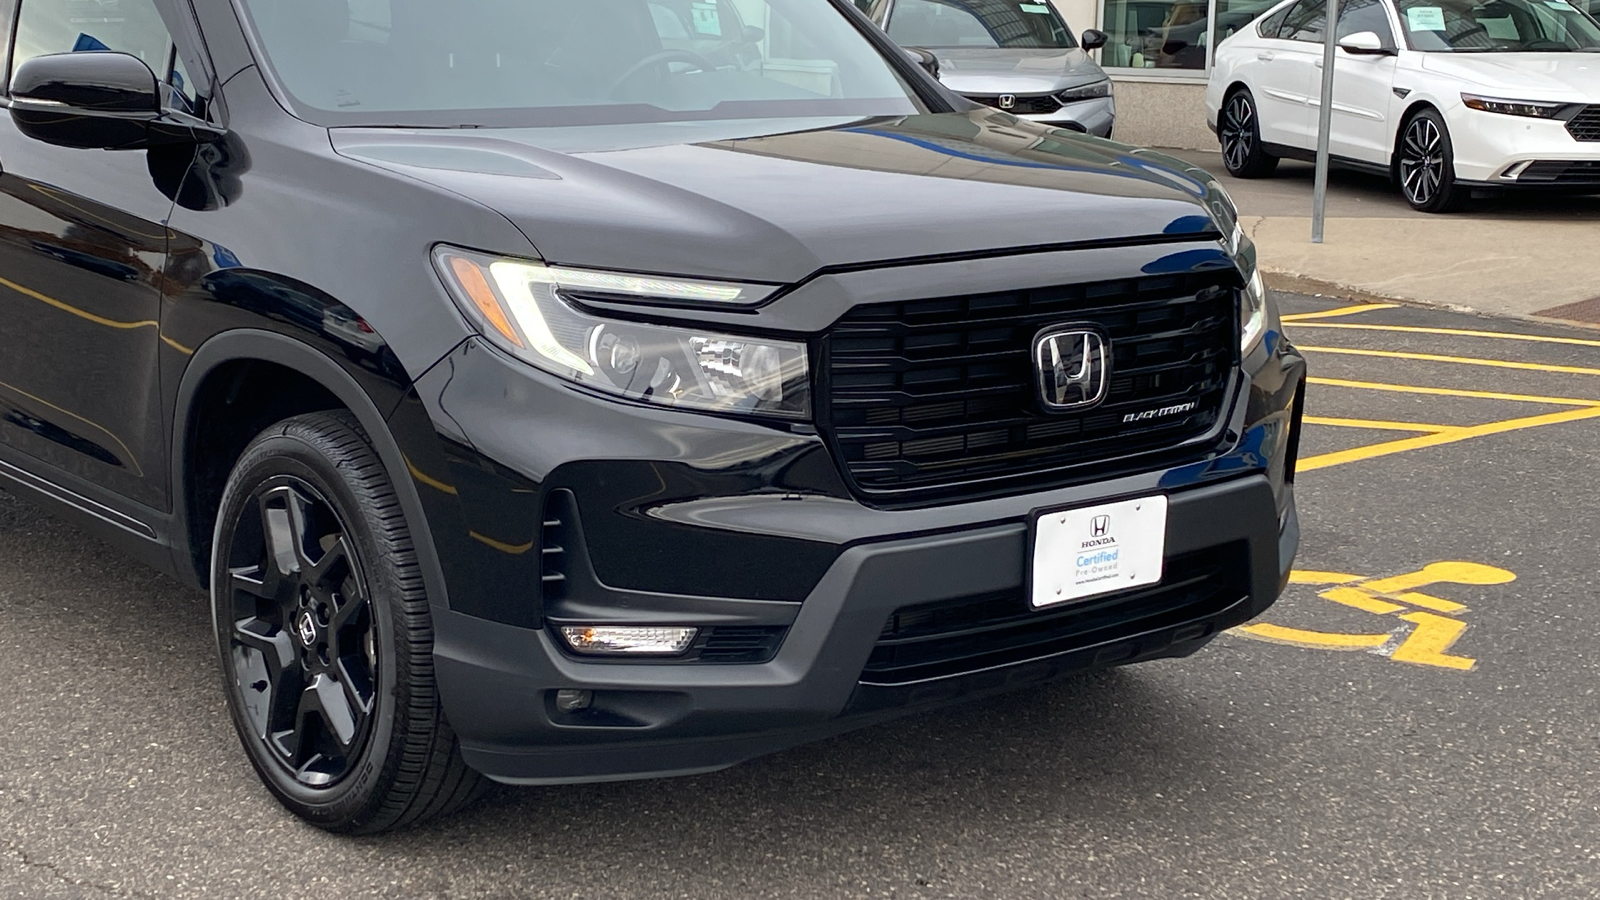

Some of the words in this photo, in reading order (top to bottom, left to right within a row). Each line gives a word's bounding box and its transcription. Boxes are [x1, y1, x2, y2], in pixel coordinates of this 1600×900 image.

[1123, 409, 1158, 423] BLACK
[1158, 402, 1195, 417] EDITION
[1081, 536, 1116, 548] HONDA
[1076, 548, 1119, 567] Certified
[1075, 562, 1118, 577] Pre-Owned
